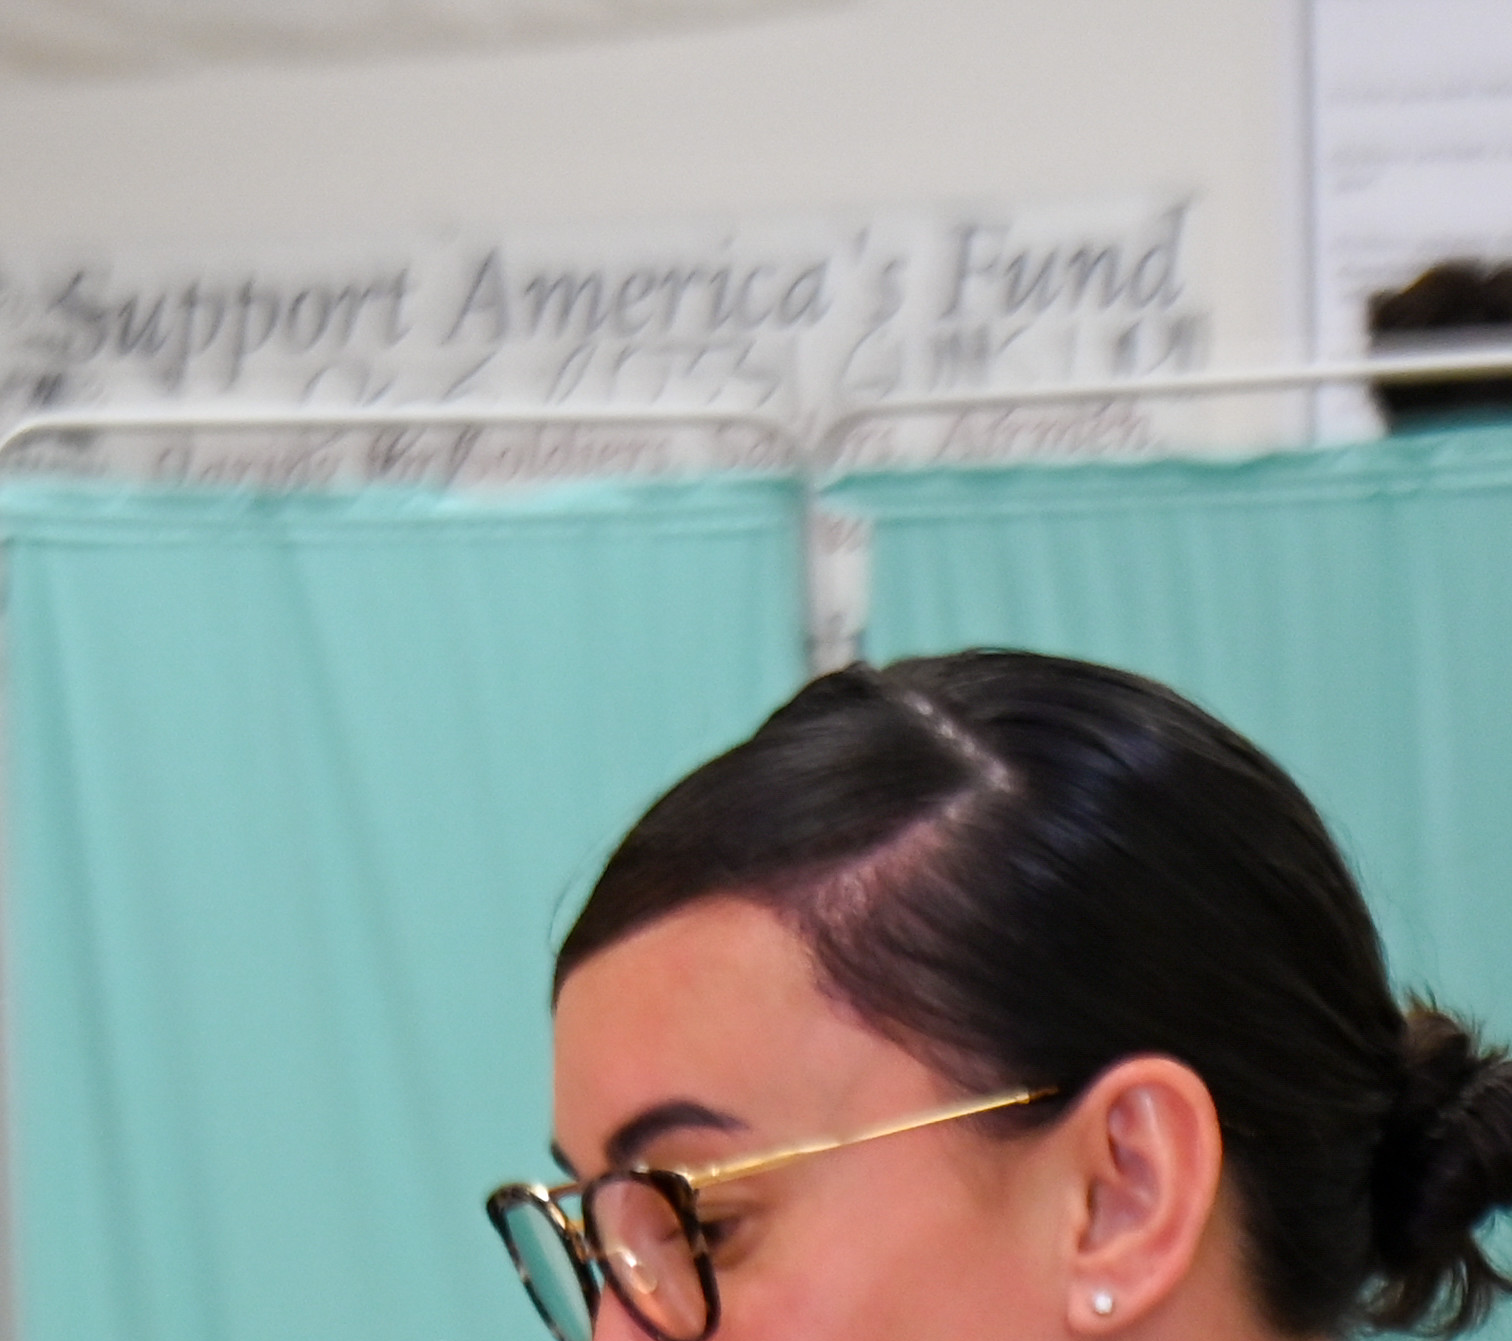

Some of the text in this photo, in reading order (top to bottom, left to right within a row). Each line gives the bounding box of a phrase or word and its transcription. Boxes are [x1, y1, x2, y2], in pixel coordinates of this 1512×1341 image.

[46, 268, 414, 395] Support
[438, 222, 911, 346] America's
[938, 192, 1192, 319] Fund
